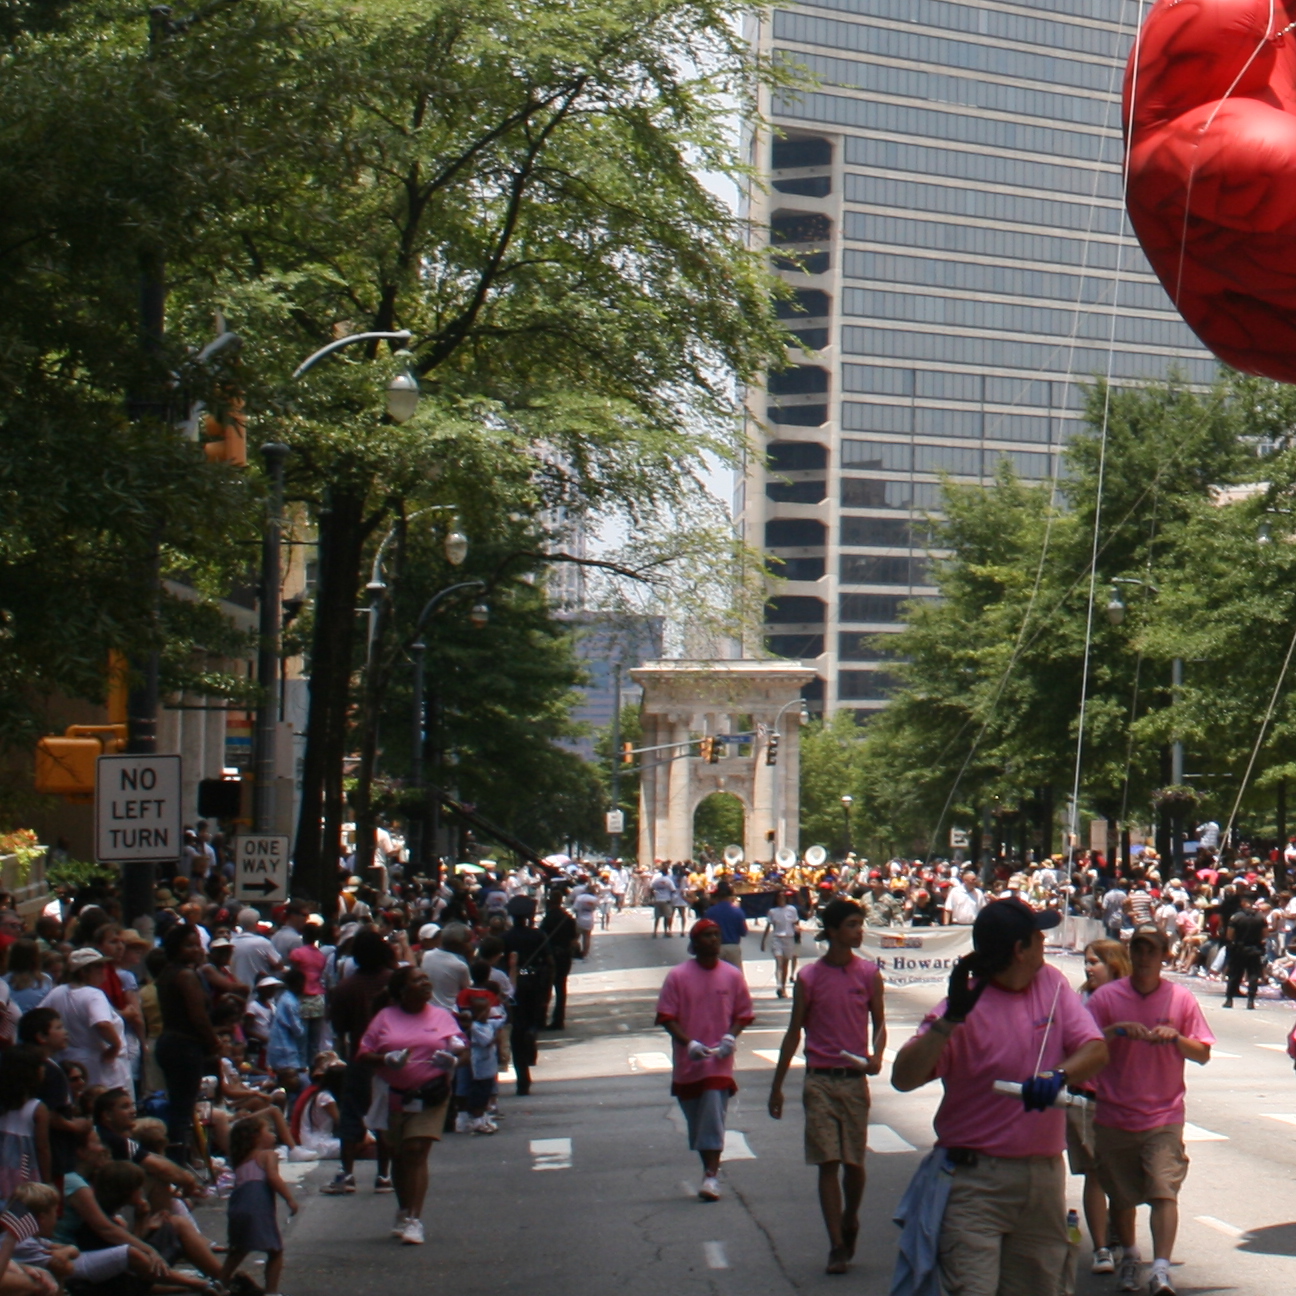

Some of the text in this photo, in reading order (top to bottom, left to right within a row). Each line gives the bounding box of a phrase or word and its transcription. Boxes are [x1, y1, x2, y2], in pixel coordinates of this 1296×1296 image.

[121, 767, 157, 791] NO
[111, 800, 165, 820] LEFT
[109, 828, 169, 848] TURN
[244, 840, 280, 855] ONE
[242, 858, 281, 873] WAY
